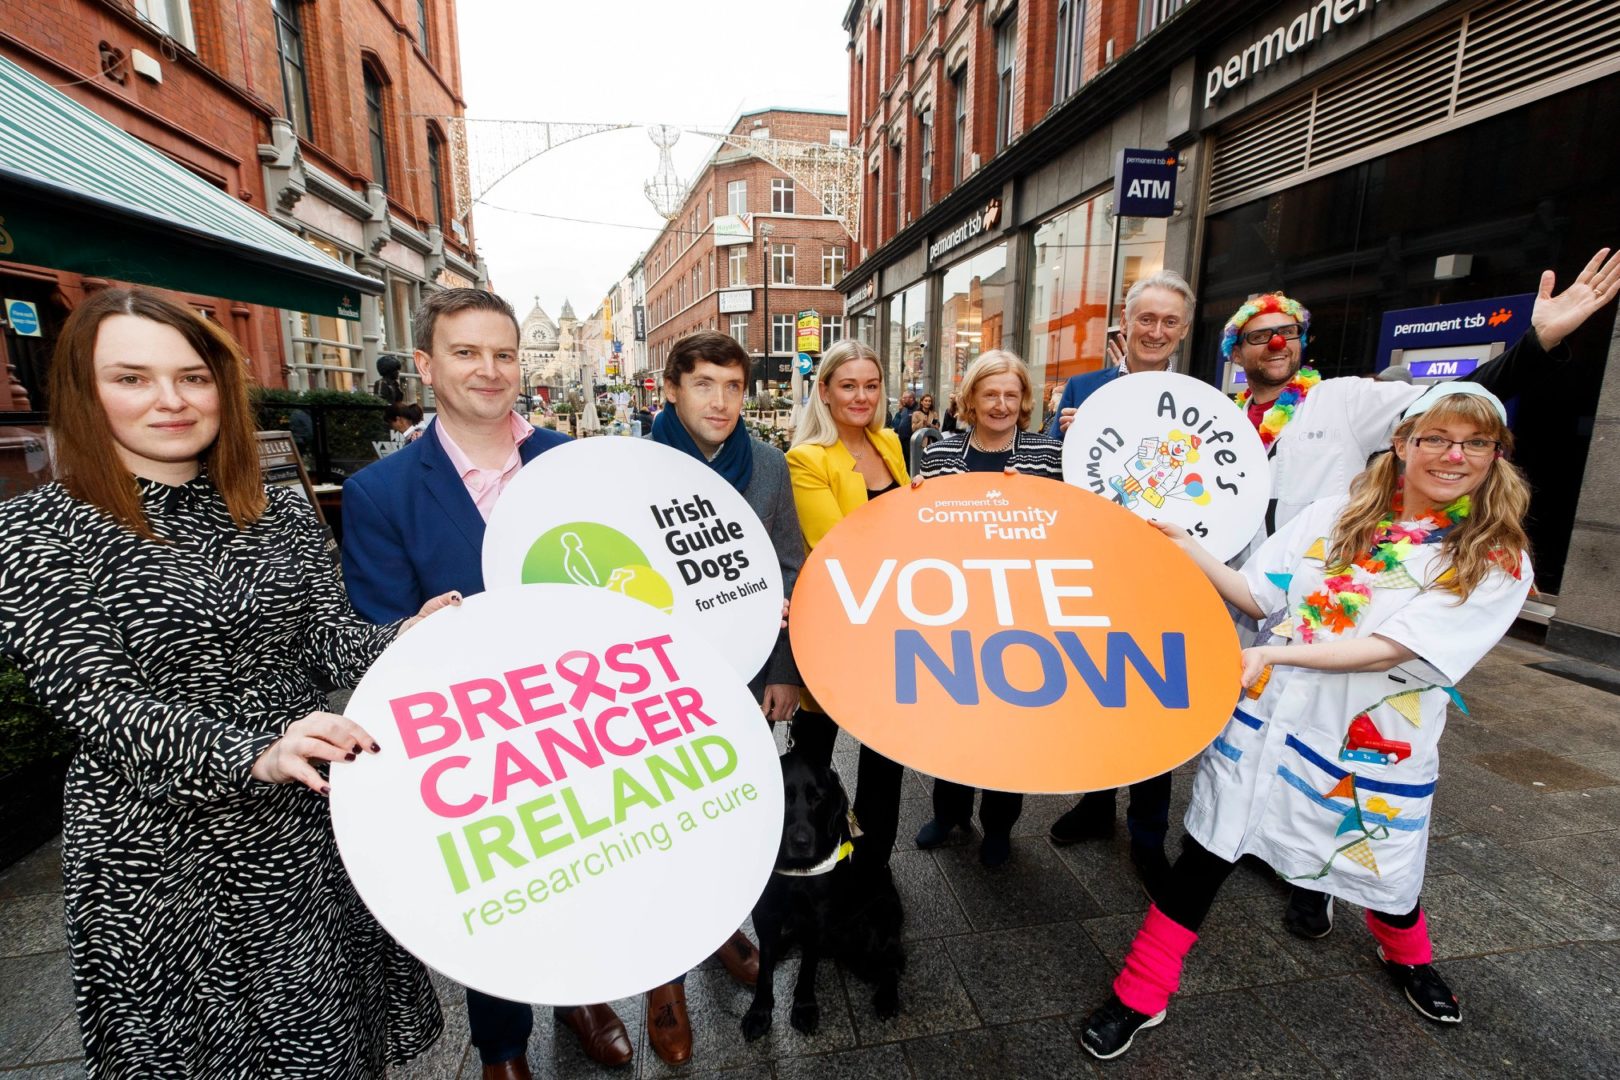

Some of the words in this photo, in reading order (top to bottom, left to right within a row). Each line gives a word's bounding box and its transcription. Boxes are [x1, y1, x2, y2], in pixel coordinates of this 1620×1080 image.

[1127, 179, 1170, 199] ATM
[930, 221, 967, 263] permanent
[968, 210, 982, 237] tsb
[1394, 317, 1461, 337] permanent
[1464, 313, 1486, 328] tsb
[1426, 361, 1458, 375] ATM
[1086, 427, 1125, 495] Clown
[1157, 391, 1246, 496] Aoife's
[650, 494, 717, 530] Irish
[918, 506, 1058, 526] Community
[935, 499, 990, 507] permanent
[993, 498, 1010, 507] tsb
[665, 518, 744, 556] Guide
[984, 523, 1047, 540] Fund
[676, 549, 750, 586] Dogs
[695, 597, 715, 612] for
[716, 591, 738, 605] the
[736, 577, 768, 598] blind
[825, 558, 1111, 627] VOTE
[894, 629, 1190, 709] NOW
[420, 686, 718, 818] CANCER
[436, 734, 739, 895] IRELAND
[462, 820, 673, 937] researching
[678, 811, 698, 832] a
[702, 783, 759, 821] cure
